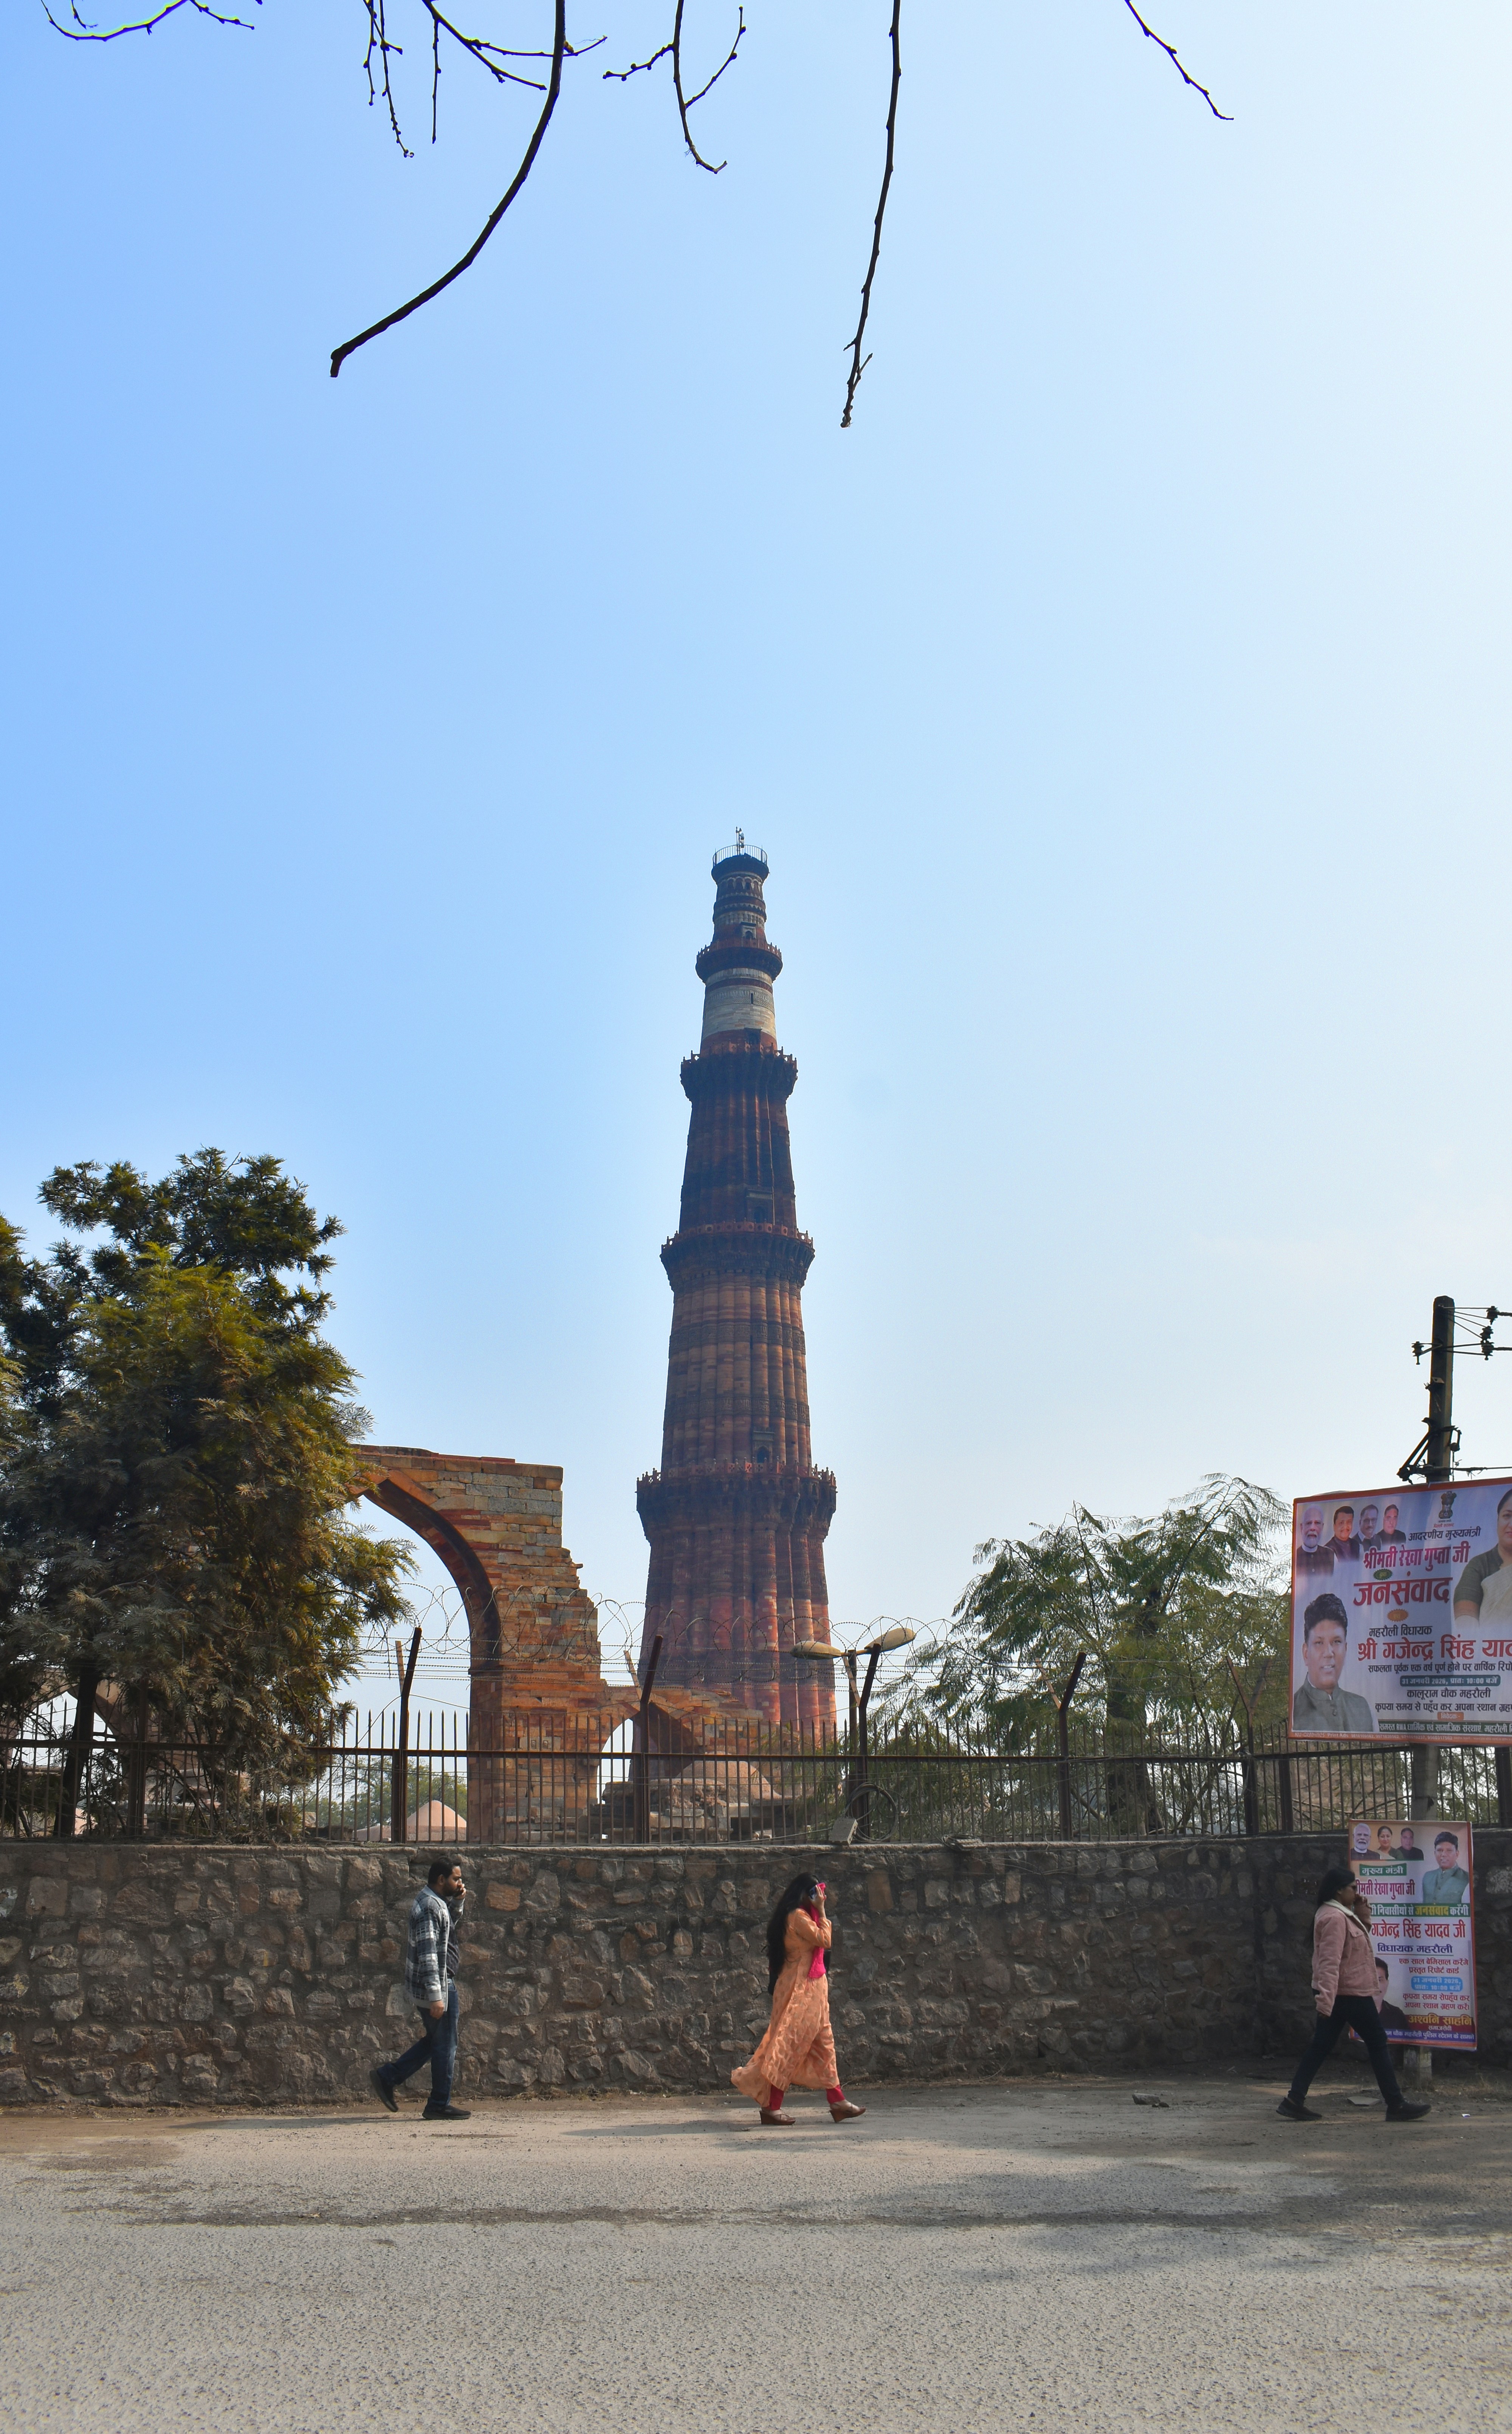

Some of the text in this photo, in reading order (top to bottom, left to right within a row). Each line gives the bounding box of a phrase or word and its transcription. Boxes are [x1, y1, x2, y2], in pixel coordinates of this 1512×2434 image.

[1408, 1526, 1481, 1541] आदरणीय मुख्यमंत्री
[1363, 1541, 1470, 1571] श्रीमती रेखा गुप्ता जी
[1353, 1571, 1453, 1606] जनसंवाद
[1369, 1625, 1398, 1637] महरौली
[1358, 1637, 1377, 1661] श्री
[1383, 1637, 1435, 1661] गजेन्द्र
[1441, 1634, 1476, 1659] सिंह
[1394, 1663, 1409, 1674] पूर्वक
[1424, 1662, 1433, 1671] वर्ष
[1435, 1662, 1445, 1673] पूर्ण
[1447, 1662, 1460, 1672] होने
[1474, 1661, 1496, 1671] वार्षिक
[1407, 1687, 1491, 1700] कालूराम चौक महरौली
[1375, 1703, 1394, 1712] कृपया
[1414, 1701, 1421, 1711] से
[1477, 1703, 1497, 1712] स्थान
[1435, 1722, 1461, 1732] सामाजिक
[1484, 1723, 1507, 1733] महरौली
[1385, 1866, 1404, 1874] मंत्री
[1374, 1879, 1388, 1895] रेखा
[1390, 1883, 1405, 1900] गुप्ता
[1406, 1879, 1415, 1895] जी
[1408, 1905, 1414, 1915] से
[1415, 1902, 1448, 1915] जनसंवाद
[1450, 1904, 1469, 1915] करेंगी
[1371, 1918, 1466, 1939] गजेन्द्र सिंह यादव जी
[1416, 1943, 1453, 1953] महरौली
[1408, 2013, 1472, 2025] अश्वनि साहनि
